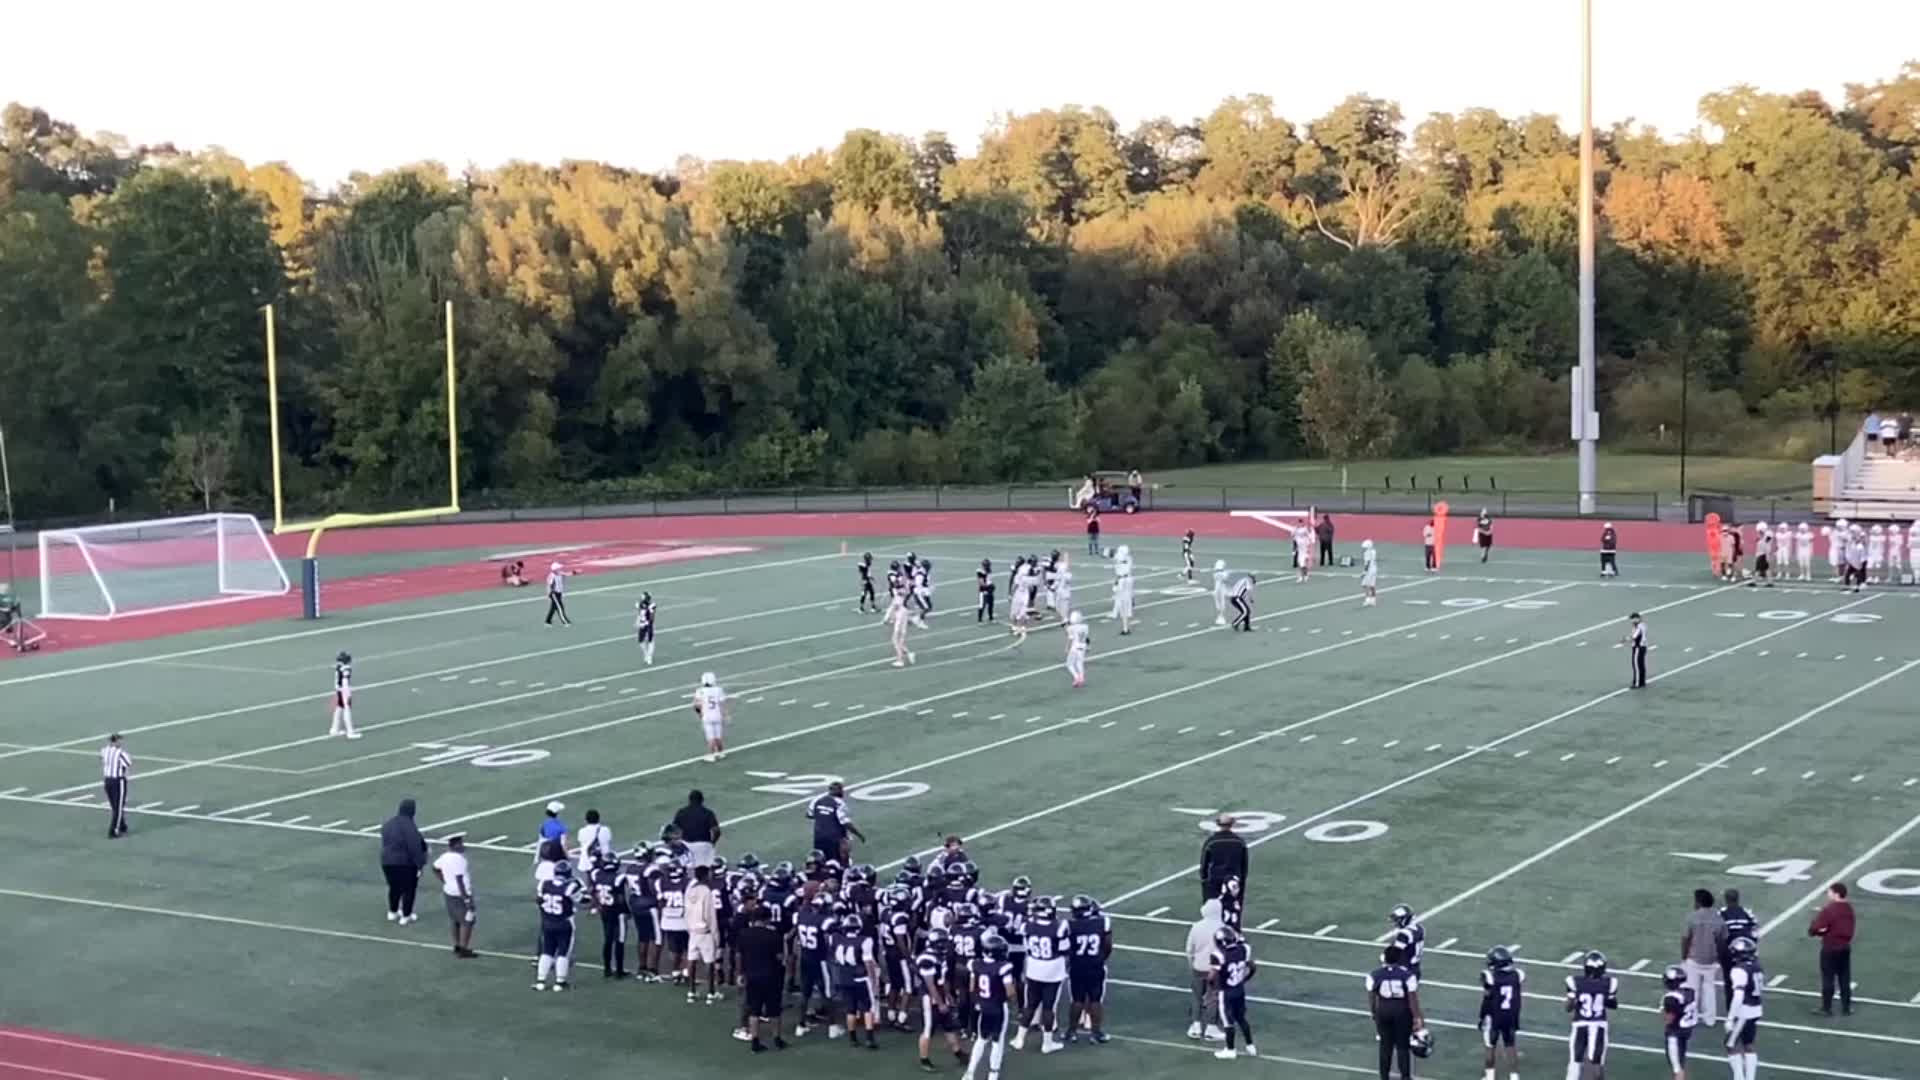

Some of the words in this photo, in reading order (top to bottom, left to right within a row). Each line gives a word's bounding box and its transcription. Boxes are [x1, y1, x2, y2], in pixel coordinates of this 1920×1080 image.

[751, 774, 931, 801] 20
[1199, 811, 1389, 843] 30
[1076, 933, 1101, 956] 73
[978, 974, 991, 999] 9
[1500, 985, 1513, 1010] 7
[1579, 993, 1604, 1018] 34
